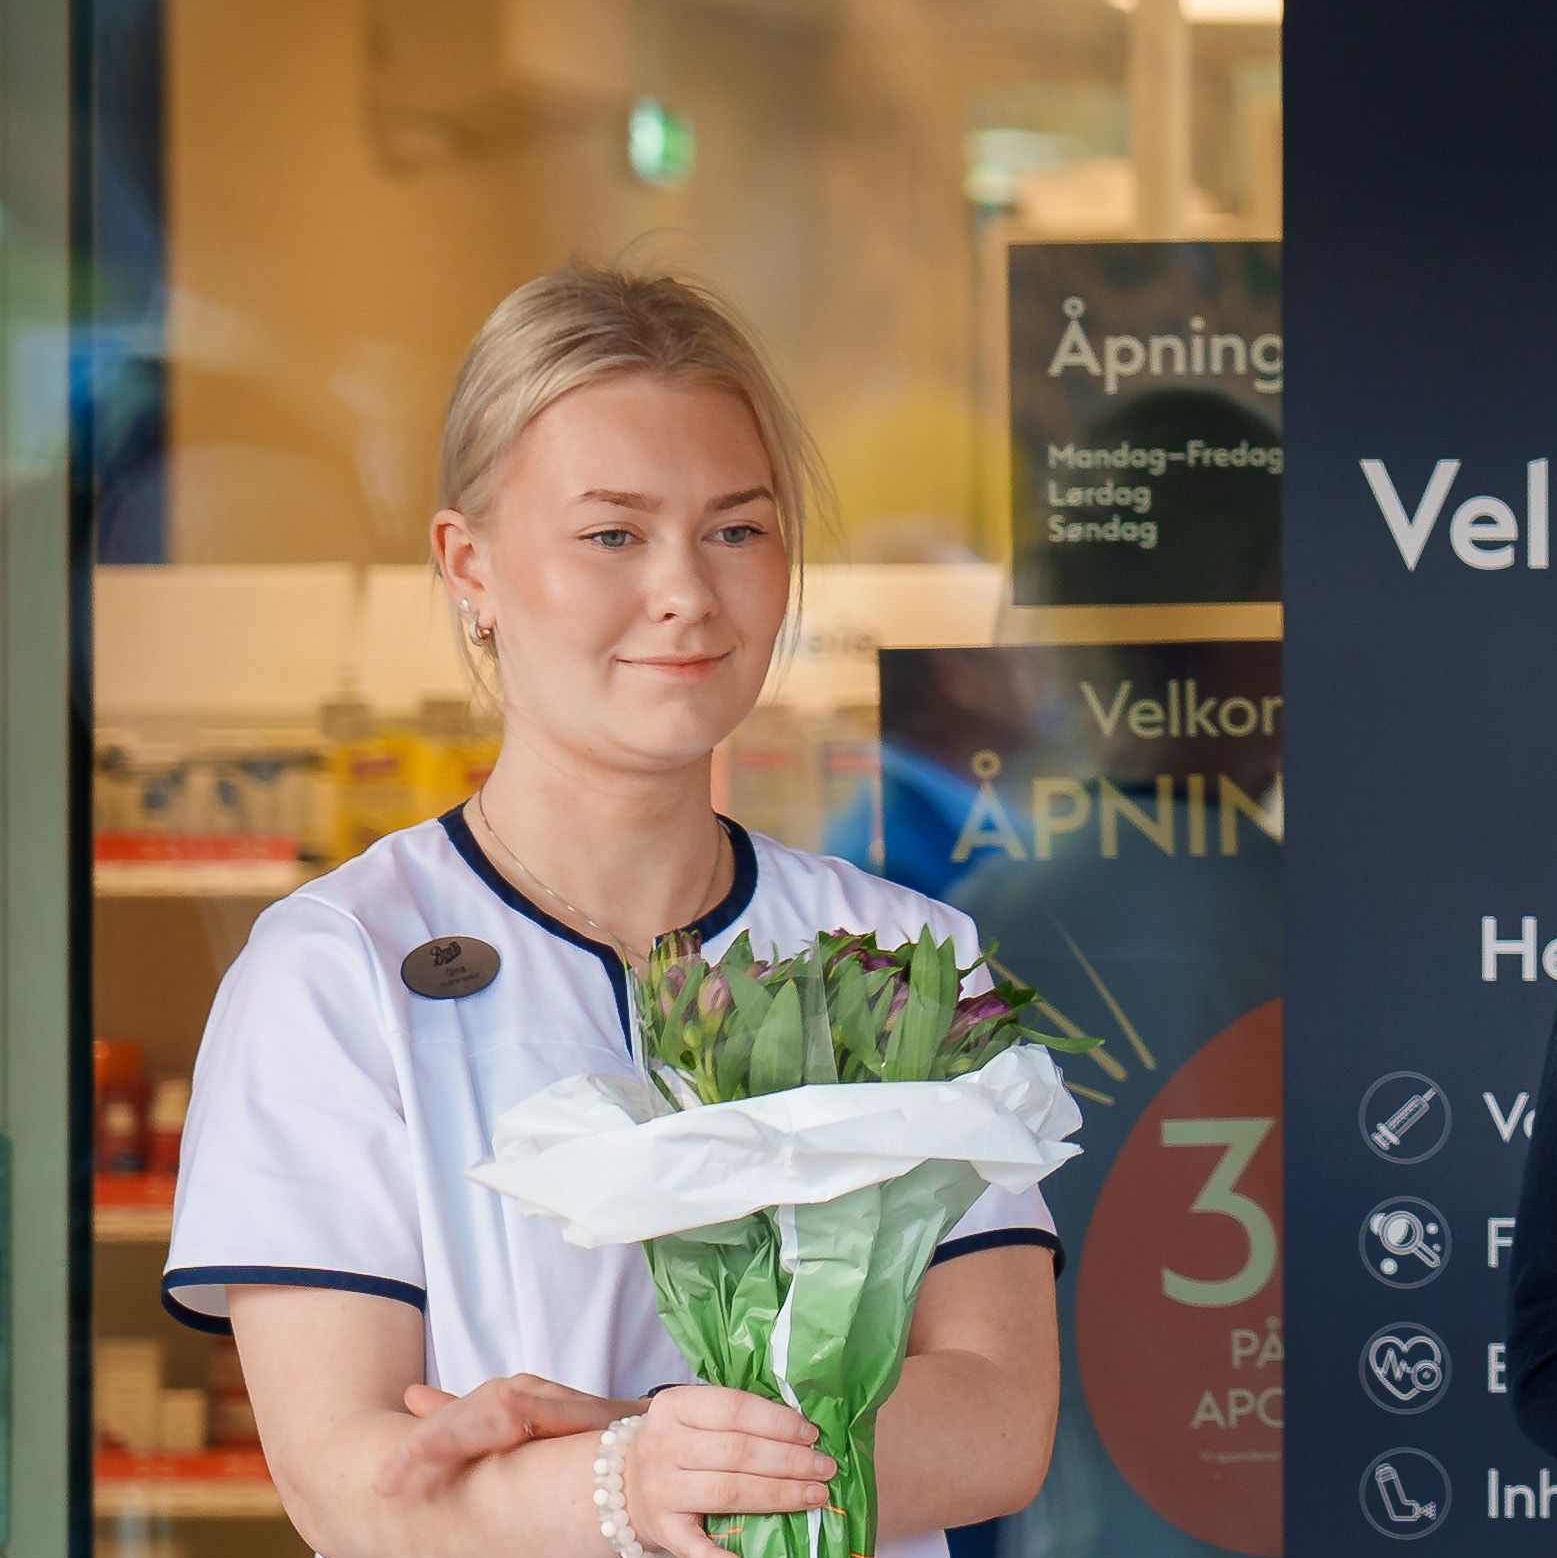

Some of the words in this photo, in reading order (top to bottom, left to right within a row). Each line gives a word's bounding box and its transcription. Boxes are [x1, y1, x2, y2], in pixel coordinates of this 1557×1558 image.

[1048, 296, 1283, 394] Åpning
[1048, 479, 1151, 514] Lørdag
[1047, 514, 1158, 550] Søndag
[1160, 1116, 1278, 1309] 3
